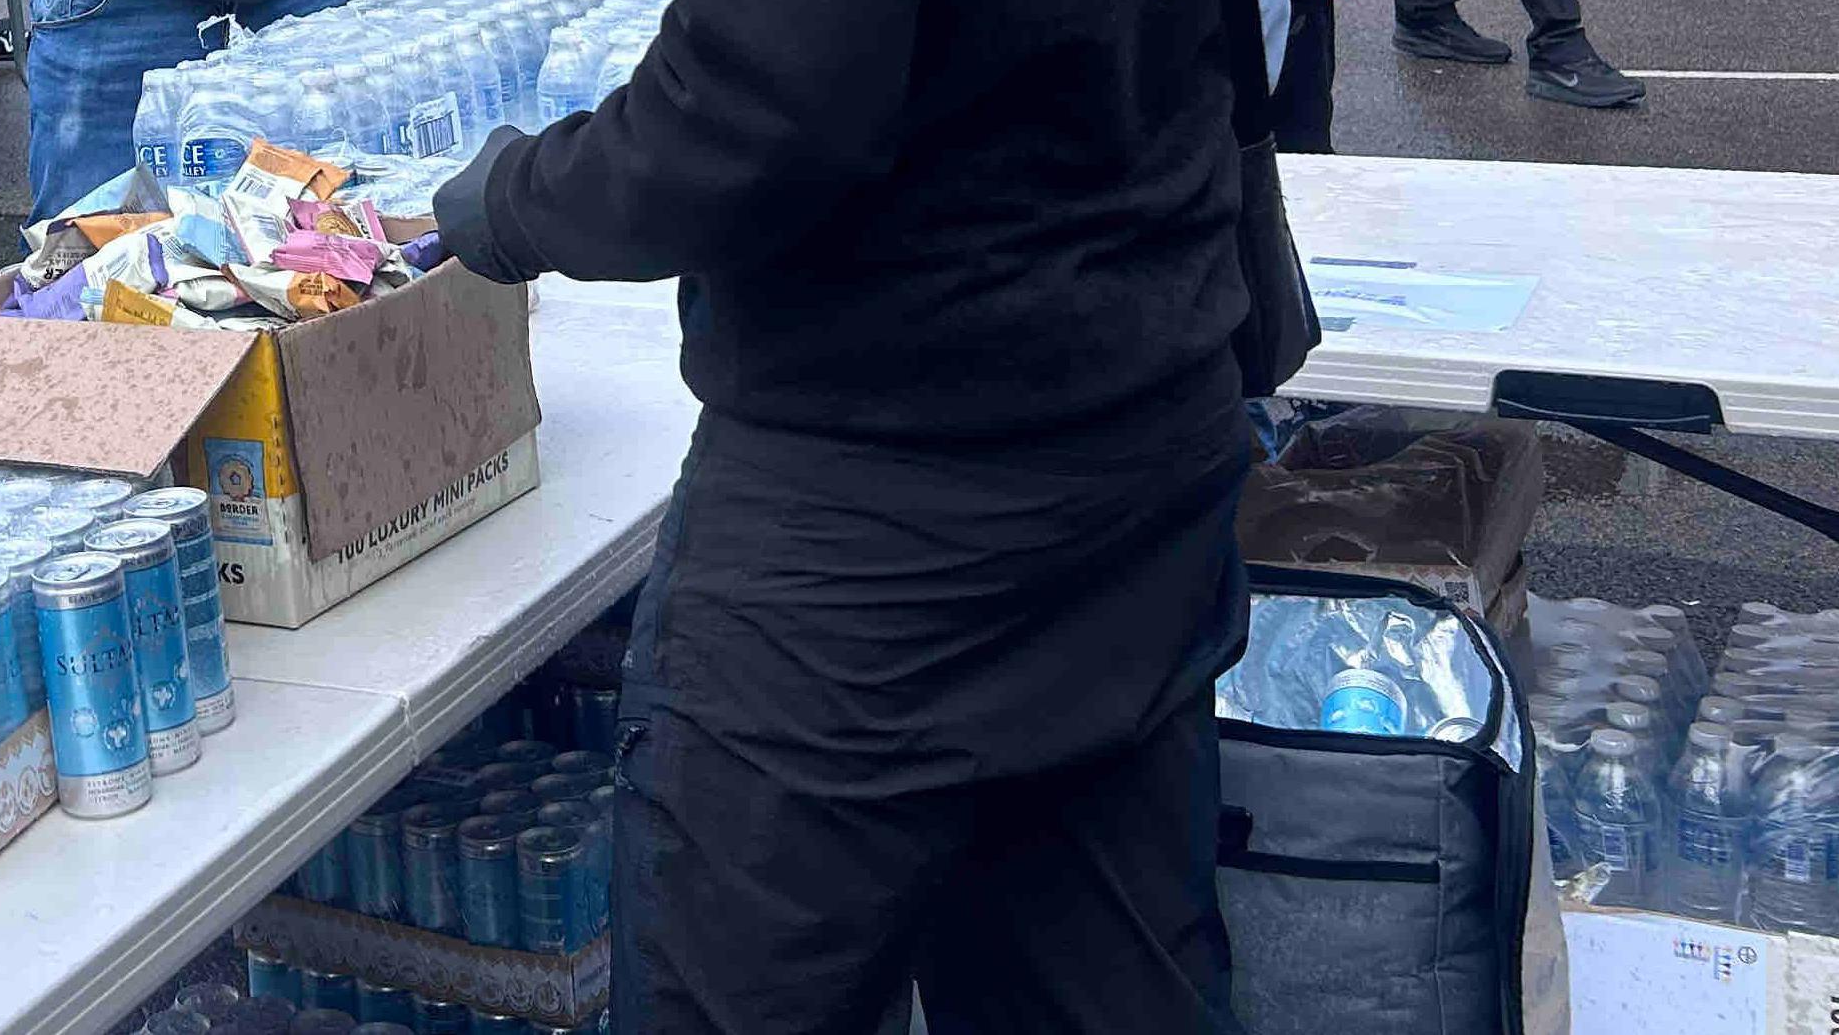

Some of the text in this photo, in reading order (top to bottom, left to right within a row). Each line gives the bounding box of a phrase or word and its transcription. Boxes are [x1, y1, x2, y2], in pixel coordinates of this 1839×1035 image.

[219, 502, 259, 516] BORDER
[368, 497, 430, 547] LUXURY
[433, 478, 464, 513] MINI
[467, 450, 510, 493] PACKS
